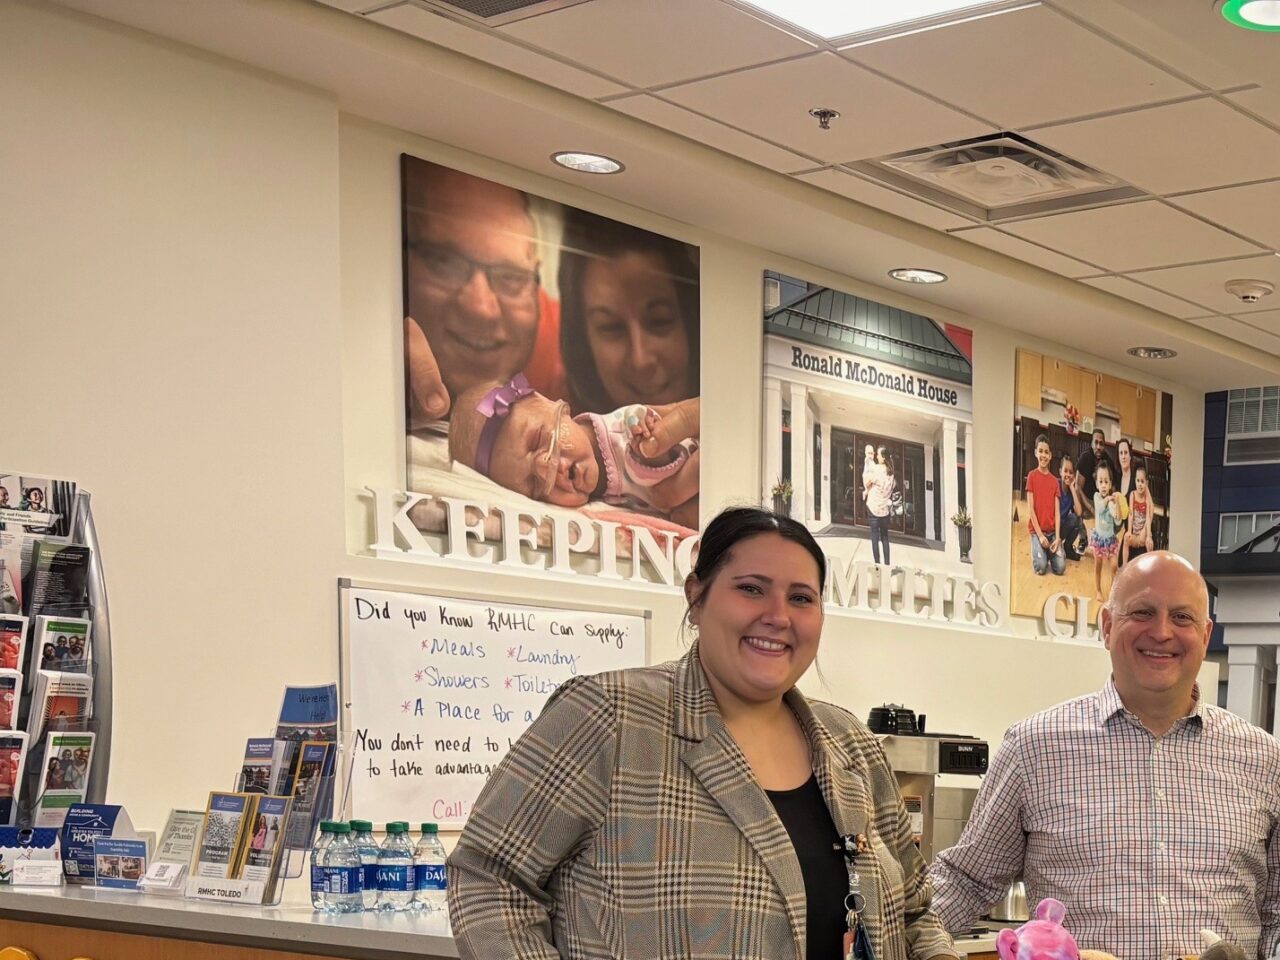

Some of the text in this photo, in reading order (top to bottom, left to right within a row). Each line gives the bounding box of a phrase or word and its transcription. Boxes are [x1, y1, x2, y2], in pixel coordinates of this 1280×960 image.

[791, 346, 958, 406] Ronald McDonald House
[823, 555, 1003, 628] MILIES
[354, 597, 390, 620] Did
[404, 608, 427, 630] you
[439, 605, 473, 628] Know
[488, 607, 536, 632] RMHC
[430, 638, 486, 658] Meals
[516, 644, 580, 675] Laundry
[424, 666, 490, 689] Showers
[414, 698, 424, 716] A
[492, 703, 514, 723] for
[524, 710, 535, 722] a
[356, 728, 382, 751] You
[435, 736, 471, 752] need
[484, 736, 499, 752] to
[366, 758, 381, 778] to
[197, 887, 241, 898] RMHC TOLEDO
